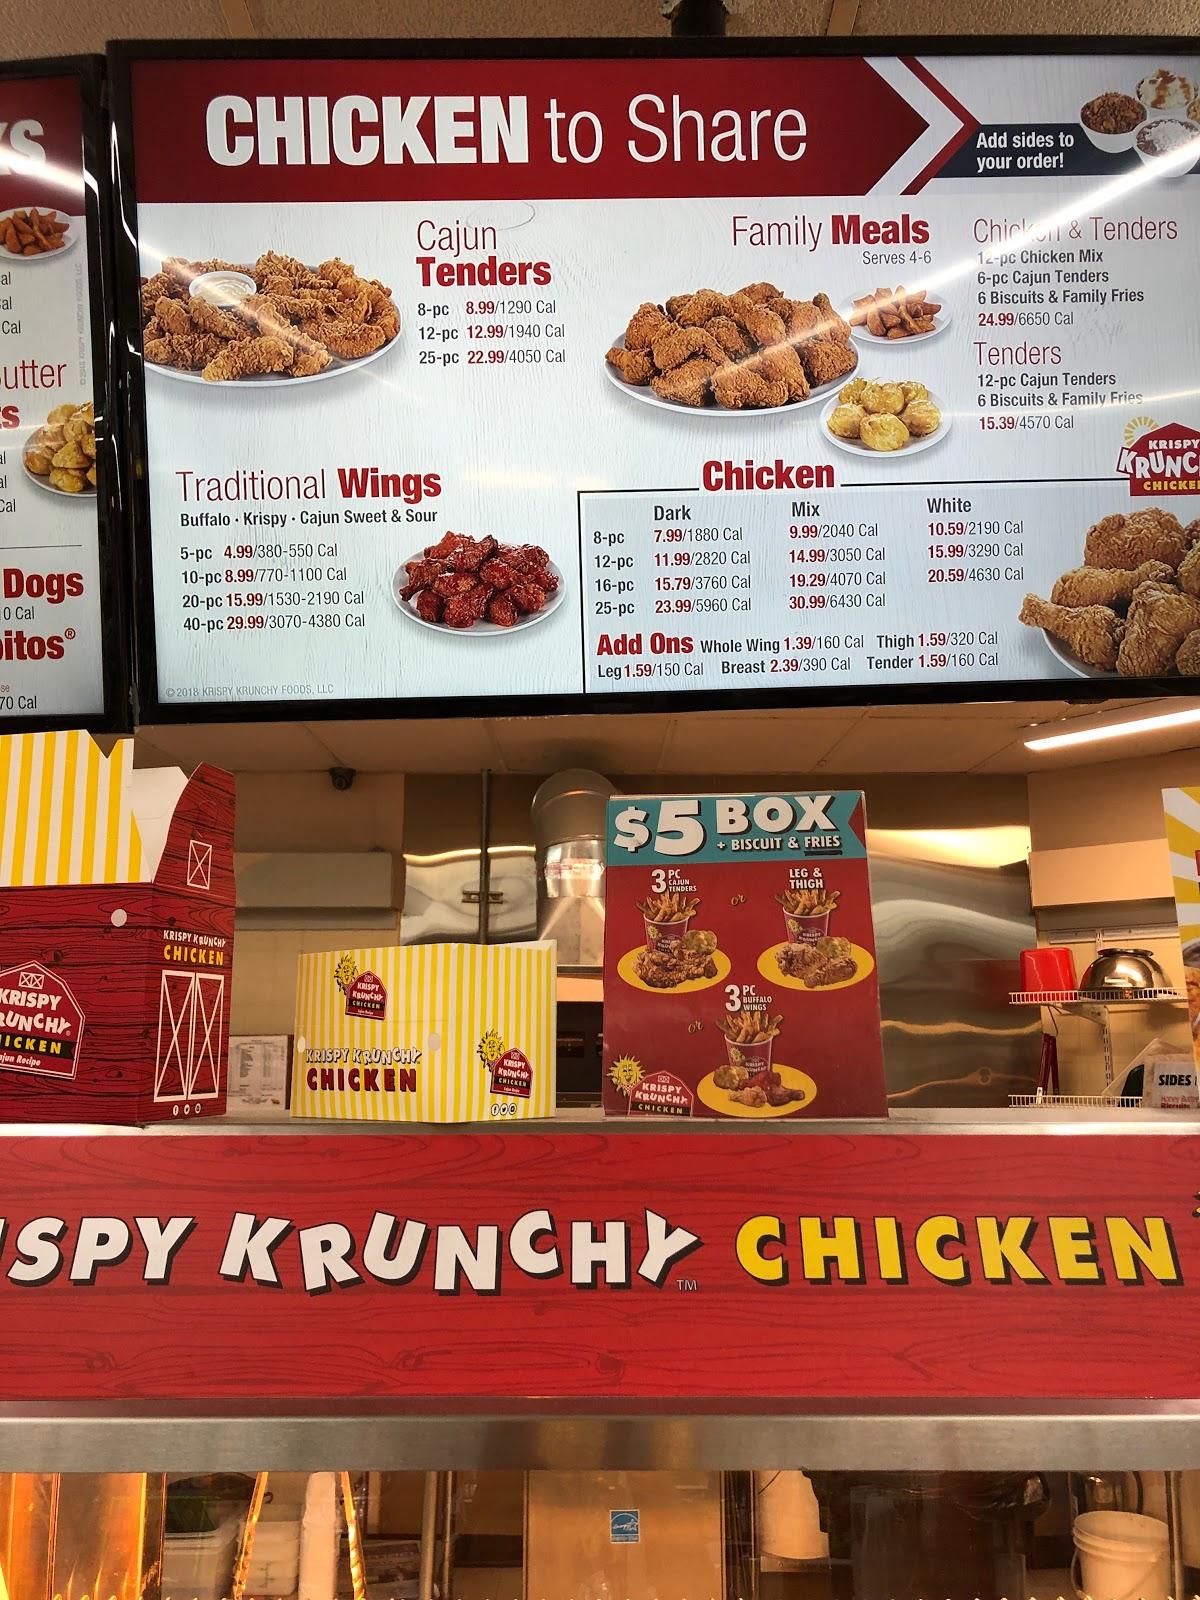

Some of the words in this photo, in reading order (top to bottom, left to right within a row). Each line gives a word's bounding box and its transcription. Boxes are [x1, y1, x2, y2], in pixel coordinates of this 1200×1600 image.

[206, 95, 528, 167] CHICKEN
[544, 98, 604, 164] to
[628, 94, 807, 163] Share
[976, 131, 1008, 149] Add
[1012, 131, 1054, 149] sides
[1058, 134, 1075, 149] to
[977, 154, 1013, 173] your
[1016, 152, 1064, 170] order!
[417, 220, 497, 257] Cajun
[732, 215, 822, 252] Family
[831, 214, 930, 245] Meals
[1068, 220, 1082, 239] &
[1089, 216, 1178, 241] Tenders
[862, 251, 906, 264] Serves
[909, 250, 932, 264] 4-6
[977, 252, 1016, 267] 12-pc
[1020, 249, 1075, 264] Chicken
[1079, 249, 1103, 263] Mix
[416, 256, 552, 287] Tenders
[977, 272, 1009, 287] 6-pc
[1012, 270, 1051, 286] Cajun
[1055, 269, 1109, 283] Tenders
[977, 291, 986, 305] 6
[990, 291, 1044, 304] Biscuits
[1048, 290, 1058, 303] &
[1063, 289, 1107, 305] Family
[1111, 288, 1144, 303] Fries
[417, 302, 450, 318] 8-pc
[466, 300, 532, 315] 8.99/1290
[536, 300, 556, 314] Cal
[978, 312, 1050, 326] 24.99/6650
[1054, 312, 1074, 325] Cal
[418, 326, 459, 343] 12-pc
[467, 324, 541, 339] 12.99/1940
[545, 323, 565, 338] Cal
[419, 351, 460, 367] 25-pc
[467, 350, 542, 364] 22.99/4050
[545, 349, 566, 363] Cal
[973, 341, 1062, 365] Tenders
[977, 374, 1016, 389] 12-pc
[1020, 373, 1058, 389] Cajun
[1062, 372, 1116, 386] Tenders
[979, 415, 1051, 430] 15.39/4570
[1054, 415, 1074, 429] Cal
[1148, 440, 1200, 449] KRISPY
[703, 459, 835, 491] Chicken
[175, 469, 326, 501] Traditional
[338, 467, 442, 504] Wings
[180, 512, 231, 527] Buffalo
[243, 511, 287, 527] Krispy
[300, 511, 339, 527] Cajun
[344, 509, 387, 524] Sweet
[391, 510, 401, 523] &
[405, 509, 438, 522] Sour
[654, 505, 692, 521] Dark
[792, 501, 820, 517] Mix
[927, 498, 972, 513] White
[593, 531, 625, 546] 8-pc
[654, 527, 719, 543] 7.99/1880
[723, 527, 743, 541] Cal
[789, 524, 854, 538] 9.99/2040
[858, 523, 878, 537] Cal
[928, 521, 1000, 536] 10.59/2190
[1004, 520, 1024, 534] Cal
[180, 546, 213, 562] 5-pc
[224, 544, 313, 559] 4.99/380-550
[317, 543, 338, 557] Cal
[594, 555, 634, 571] 12-pc
[654, 551, 727, 567] 11.99/2820
[731, 551, 750, 564] Cal
[789, 548, 862, 563] 14.99/3050
[866, 547, 886, 561] Cal
[928, 543, 1001, 559] 15.99/3290
[1004, 543, 1024, 557] Cal
[3, 568, 84, 603] Dogs
[182, 570, 222, 586] 10-pc
[224, 567, 323, 583] 8.99/770-1100
[326, 567, 347, 581] Cal
[595, 578, 634, 594] 16-pc
[655, 576, 727, 591] 15.79/3760
[731, 575, 751, 589] Cal
[789, 572, 862, 587] 19.29/4070
[866, 571, 886, 585] Cal
[928, 568, 1001, 583] 20.59/4630
[1004, 567, 1024, 581] Cal
[182, 594, 223, 610] 20-pc
[226, 591, 340, 607] 15.99/1530-2190
[344, 590, 364, 605] Cal
[595, 602, 635, 617] 25-pc
[655, 599, 728, 614] 23.99/5960
[732, 598, 751, 612] Cal
[789, 594, 862, 609] 30.99/6430
[866, 593, 886, 607] Cal
[183, 617, 224, 633] 40-pc
[226, 614, 341, 630] 29.99/3070-4380
[345, 613, 365, 627] Cal
[597, 634, 642, 656] Add
[650, 632, 694, 654] Ons
[700, 640, 742, 654] Whole
[746, 638, 780, 654] Wing
[784, 635, 840, 650] 1.39/160
[844, 635, 864, 649] Cal
[876, 634, 914, 650] Thigh
[918, 632, 974, 647] 1.59/320
[978, 631, 998, 645] Cal
[598, 665, 622, 680] Leg
[624, 663, 680, 678] 1.59/150
[684, 662, 703, 676] Cal
[721, 660, 765, 674] Breast
[770, 658, 827, 673] 2.39/390
[831, 657, 851, 671] Cal
[867, 655, 914, 670] Tender
[918, 653, 975, 668] 1.59/160
[978, 652, 998, 666] Cal
[202, 686, 233, 696] KRISPY
[236, 685, 278, 696] KRUNCHY
[317, 684, 334, 693] LLC
[613, 800, 707, 856] $5
[716, 795, 838, 835] BOX
[731, 837, 782, 851] BISCUIT
[787, 837, 799, 849] &
[804, 835, 840, 849] FRIES
[651, 868, 667, 893] 3
[668, 869, 681, 879] PC
[789, 868, 808, 879] LEG
[813, 868, 823, 878] &
[789, 878, 823, 889] THIGH
[163, 930, 192, 942] KRISPY
[193, 934, 226, 947] KRUNCHY
[163, 944, 224, 966] CHICKEN
[725, 984, 741, 1012] 3
[742, 985, 756, 996] PC
[742, 996, 772, 1004] BUFFALO
[743, 1003, 767, 1011] WINGS
[306, 1048, 349, 1063] KRISPY
[352, 1047, 422, 1065] KRUNCHY
[306, 1068, 417, 1091] CHICKEN
[642, 1082, 682, 1094] KRISPY
[1158, 1074, 1192, 1086] SIDES
[635, 1091, 688, 1104] KRUNCHY
[0, 1215, 198, 1287] SPY
[218, 1208, 704, 1297] KRUNCHY
[735, 1215, 1184, 1286] CHICKEN
